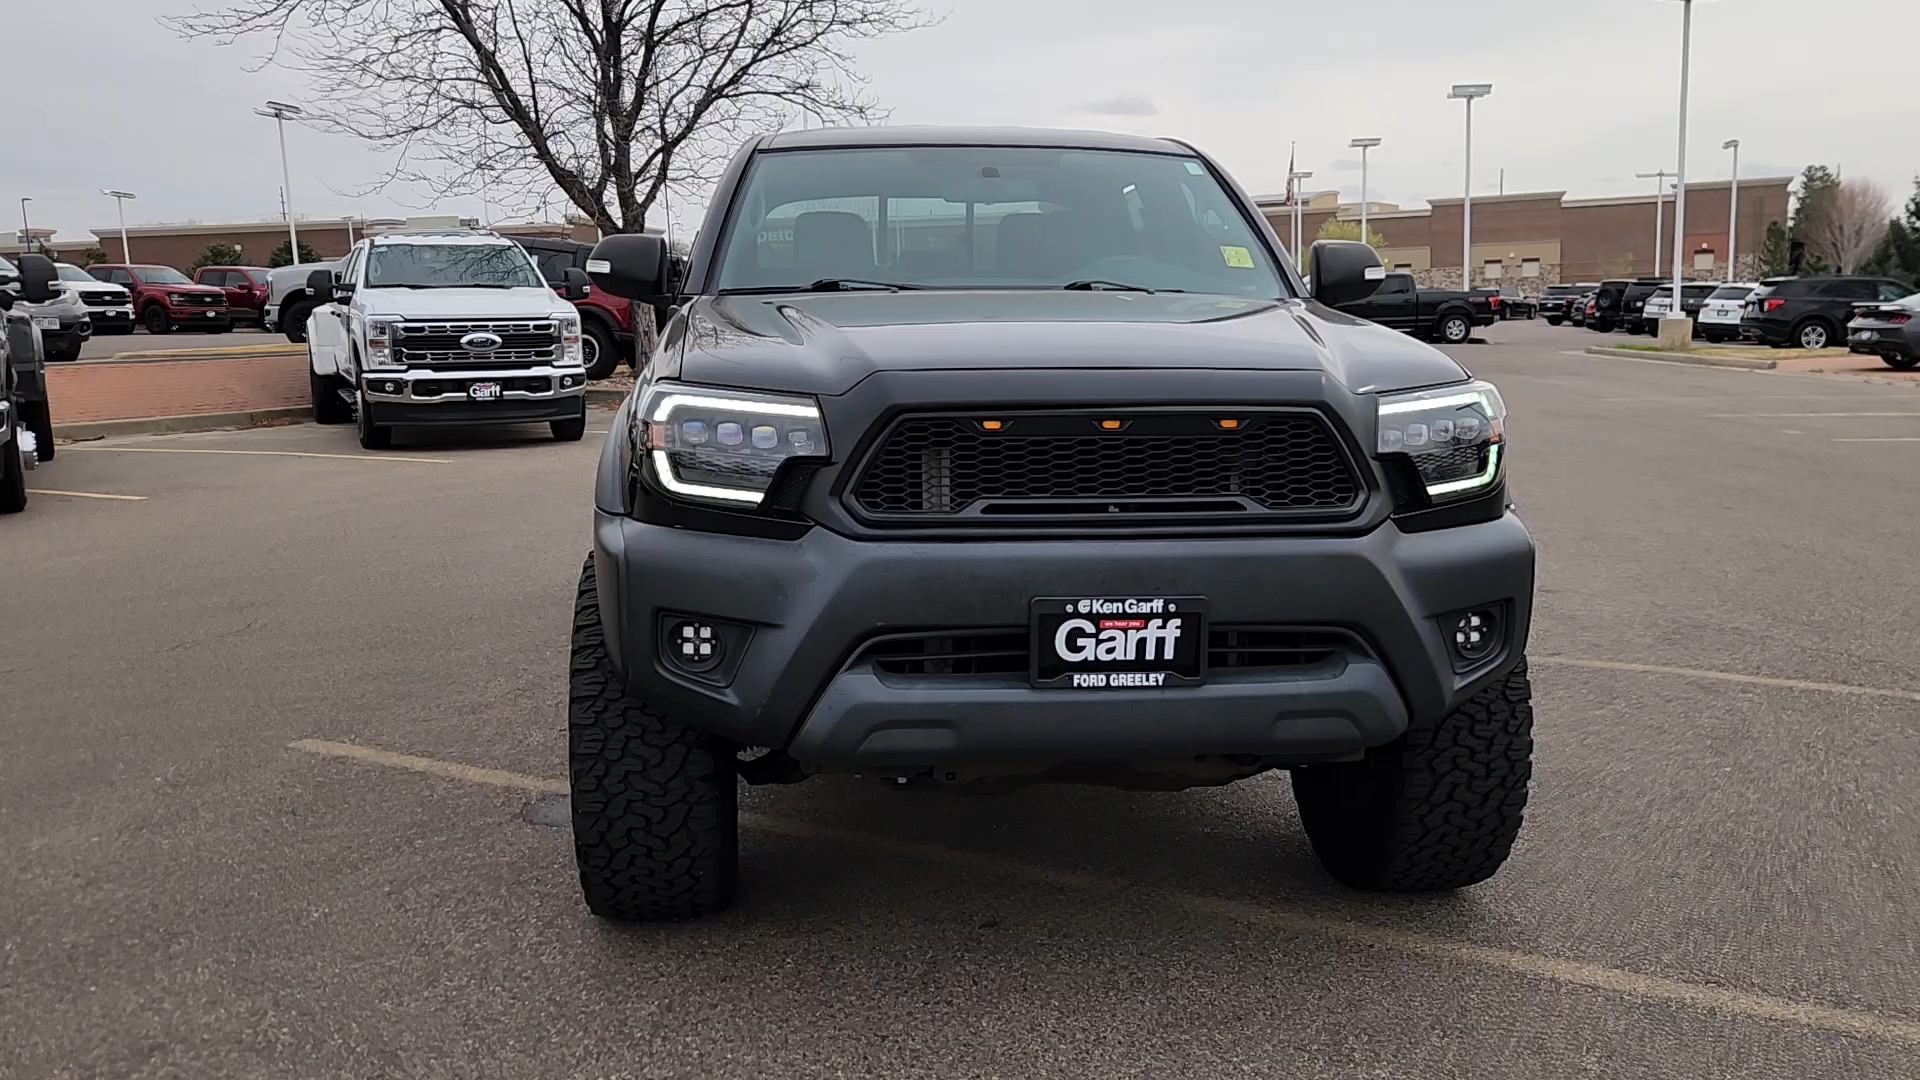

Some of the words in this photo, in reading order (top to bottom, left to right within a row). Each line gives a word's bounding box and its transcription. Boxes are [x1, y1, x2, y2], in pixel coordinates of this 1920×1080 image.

[470, 385, 500, 397] Garff
[1092, 599, 1123, 613] Ken
[1124, 599, 1164, 613] Garff
[1055, 618, 1181, 662] Garff
[1073, 674, 1107, 687] FORD
[1110, 673, 1165, 687] GREELEY
